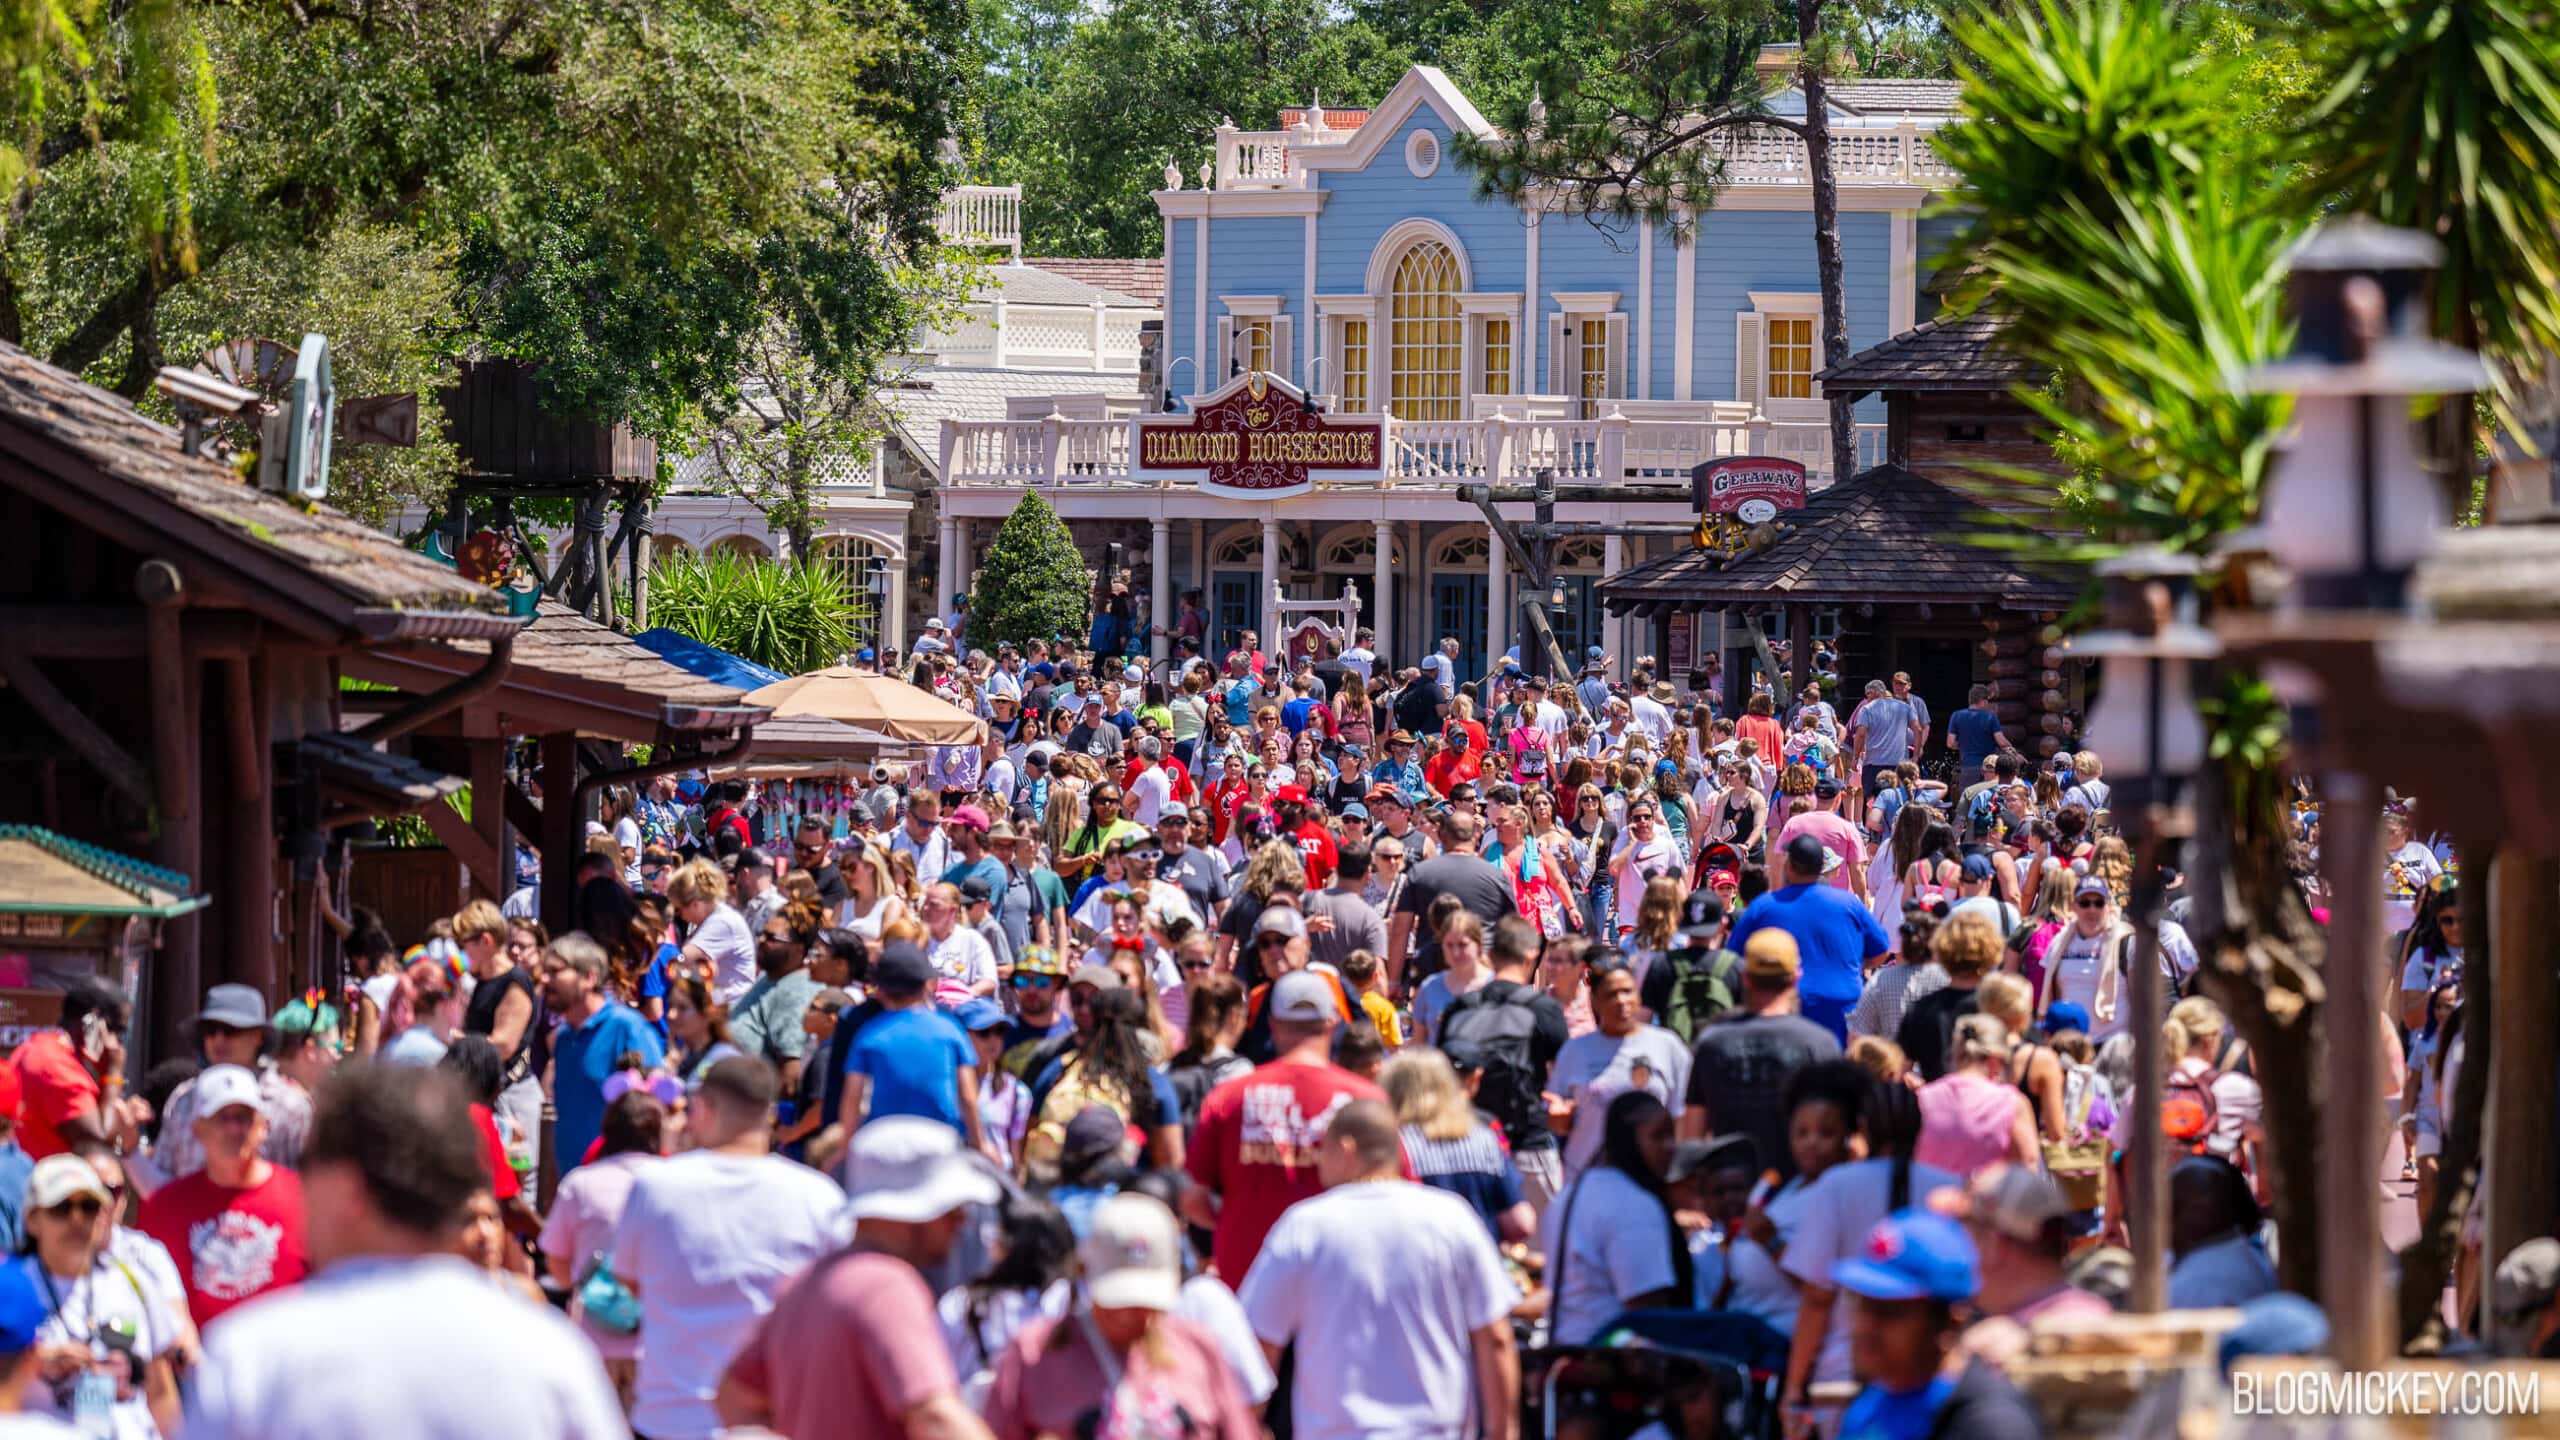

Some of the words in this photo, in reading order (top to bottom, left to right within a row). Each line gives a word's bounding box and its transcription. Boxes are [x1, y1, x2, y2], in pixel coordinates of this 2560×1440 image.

[1246, 407, 1270, 427] The
[1145, 432, 1240, 464] DIAMOND
[1247, 431, 1375, 464] HORSESHOE
[1712, 470, 1800, 495] GETAWAY
